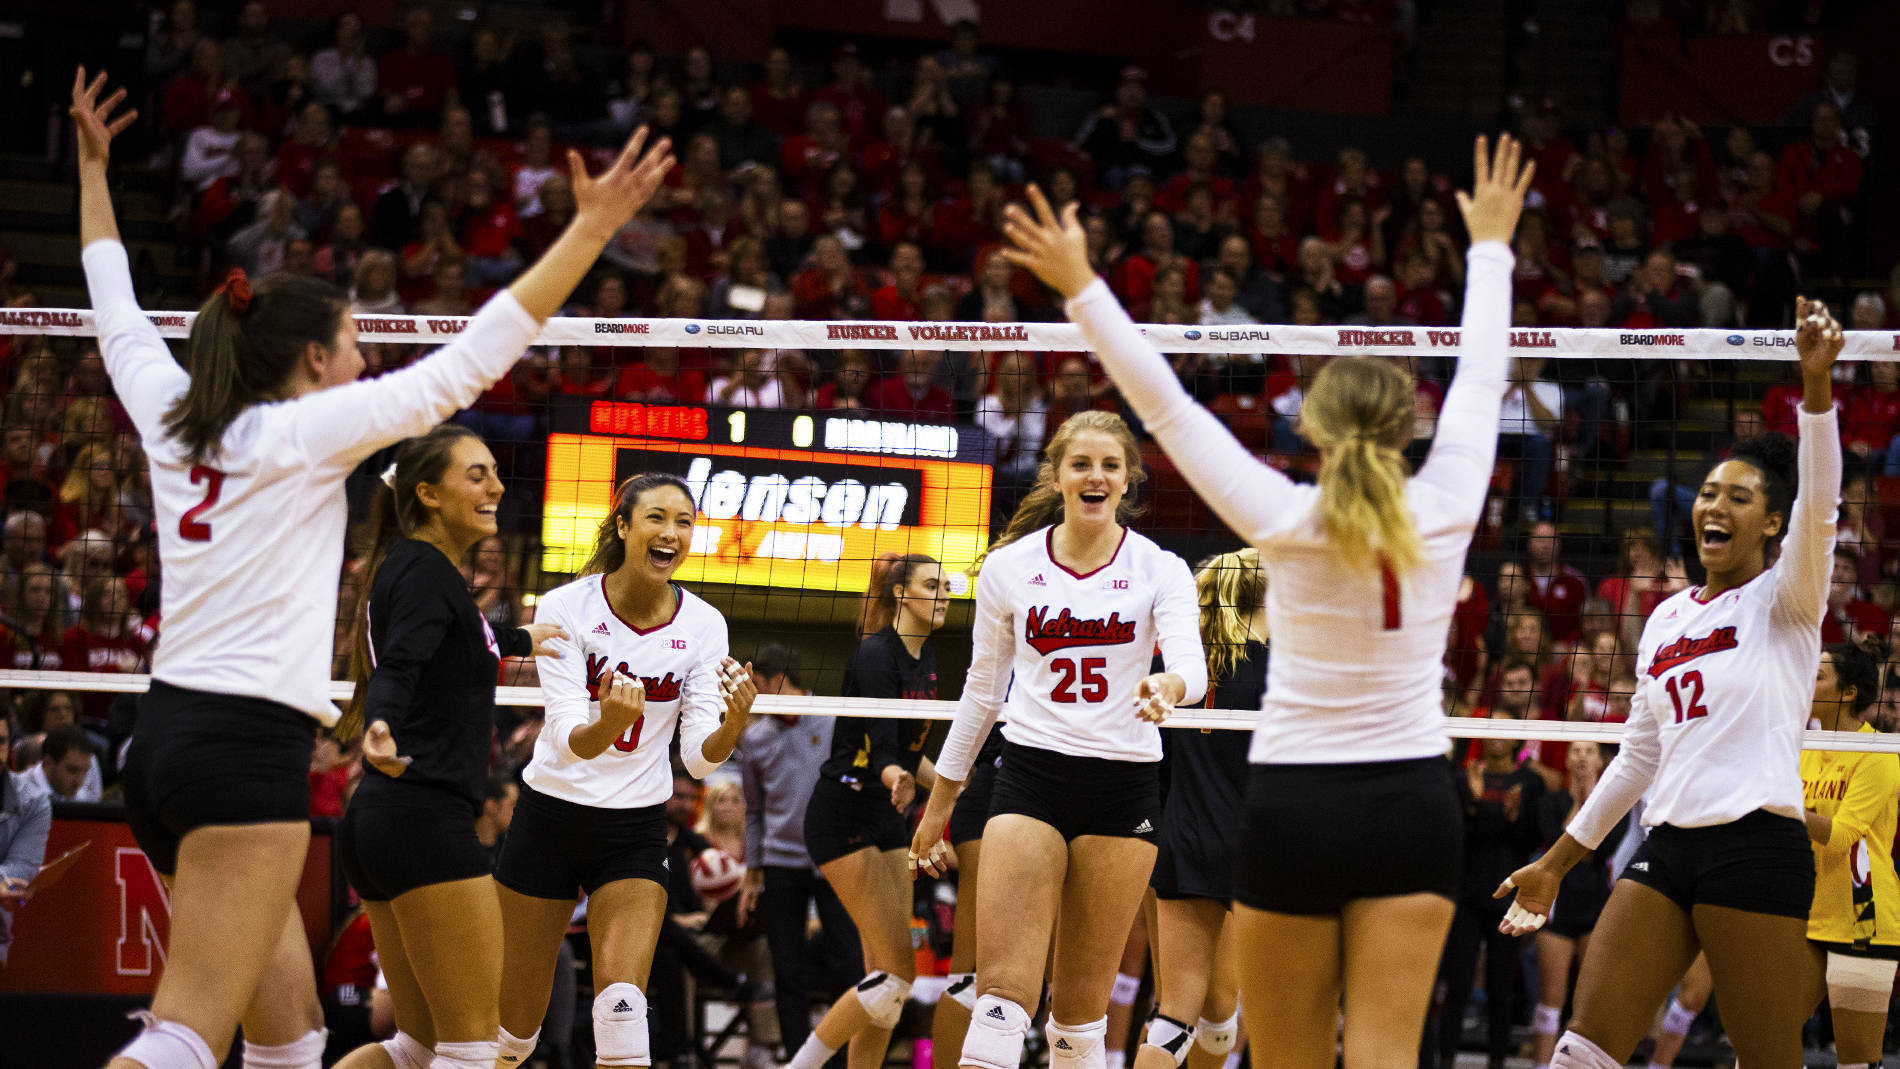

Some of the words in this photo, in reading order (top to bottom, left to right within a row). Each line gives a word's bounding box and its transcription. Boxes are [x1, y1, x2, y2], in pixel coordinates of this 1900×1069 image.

[1209, 11, 1255, 42] C4
[1768, 37, 1813, 66] C5
[594, 323, 649, 334] BEARDMORE
[707, 325, 764, 335] SUBARU
[827, 325, 898, 340] HUSKER
[908, 326, 1028, 341] VOLLEYBALL
[1209, 331, 1270, 341] SUBARU
[1338, 330, 1416, 346] HUSKER
[1620, 334, 1685, 346] BEARDMORE
[1753, 336, 1796, 347] SUBA
[728, 411, 745, 443] 1
[793, 415, 813, 447] 0
[178, 464, 227, 542] 2
[1025, 605, 1136, 646] Nebraska
[1050, 657, 1109, 703] 25
[1665, 669, 1708, 724] 12
